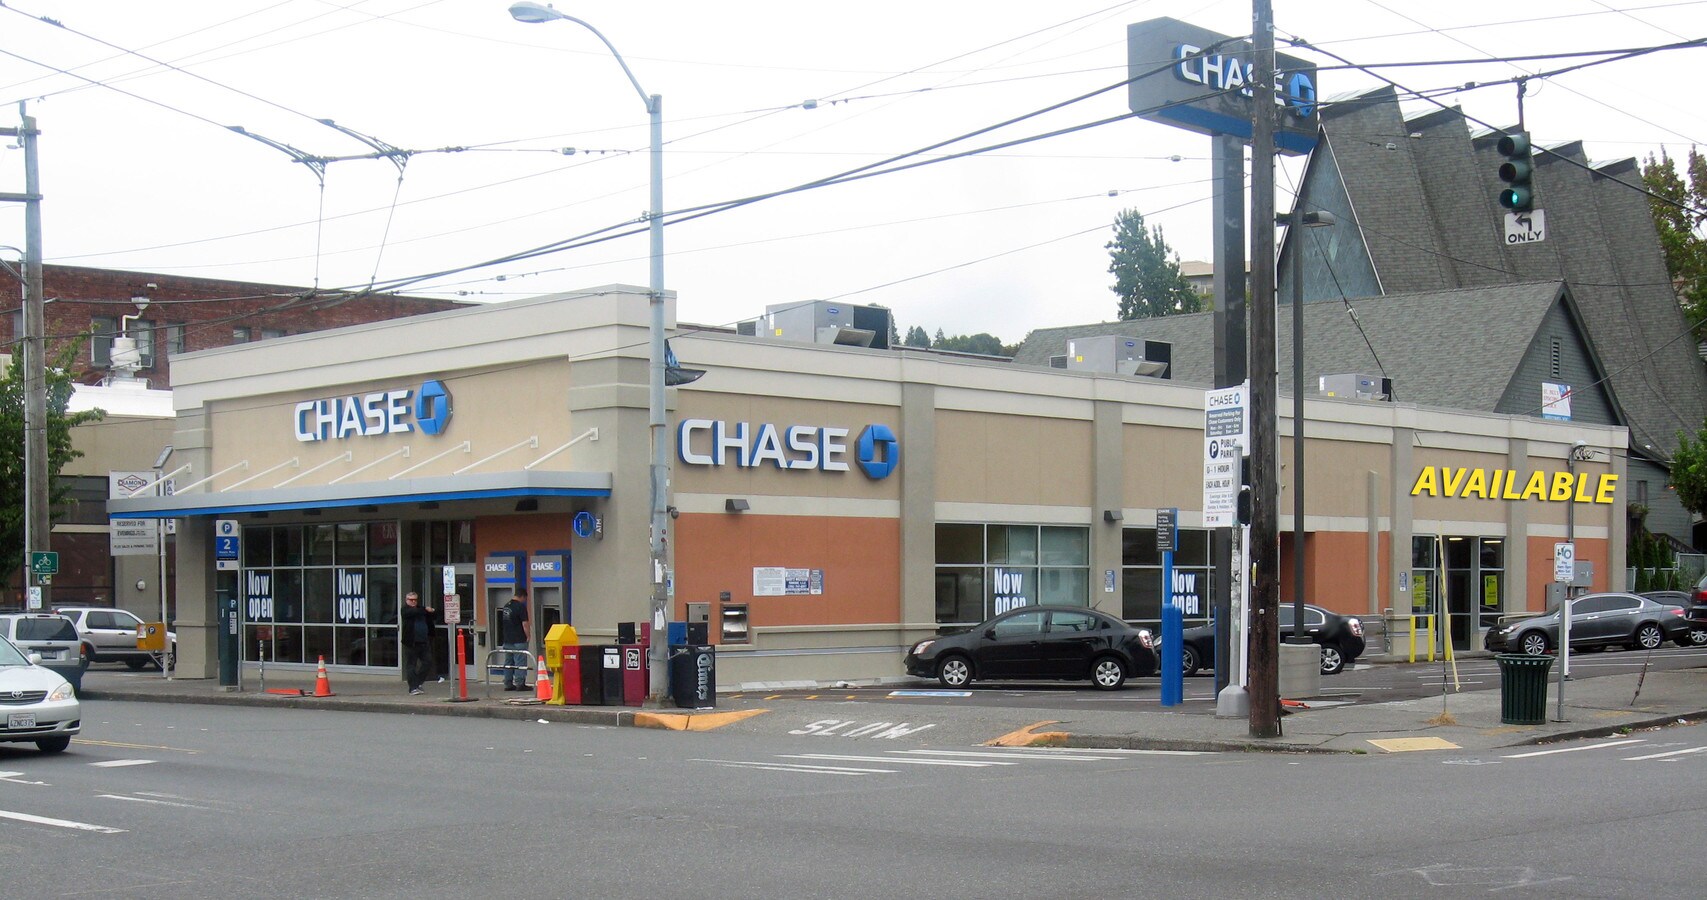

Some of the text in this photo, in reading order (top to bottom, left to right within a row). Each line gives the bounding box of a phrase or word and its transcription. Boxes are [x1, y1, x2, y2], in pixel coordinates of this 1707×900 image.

[1508, 231, 1542, 243] ONLY
[1210, 394, 1233, 406] CHASE
[294, 389, 415, 442] CHASE
[678, 418, 850, 472] CHASE
[1218, 464, 1230, 473] HOUR
[1411, 466, 1619, 504] AVAILABLE
[223, 538, 231, 550] 2
[485, 563, 507, 572] CHASE
[531, 562, 553, 571] CHASE
[248, 570, 270, 596] Now
[339, 568, 362, 595] Now
[994, 568, 1023, 595] Now
[1171, 569, 1195, 593] Now
[249, 597, 272, 622] open
[340, 597, 366, 623] open
[696, 653, 714, 700] Times
[788, 719, 937, 740] SLOW
